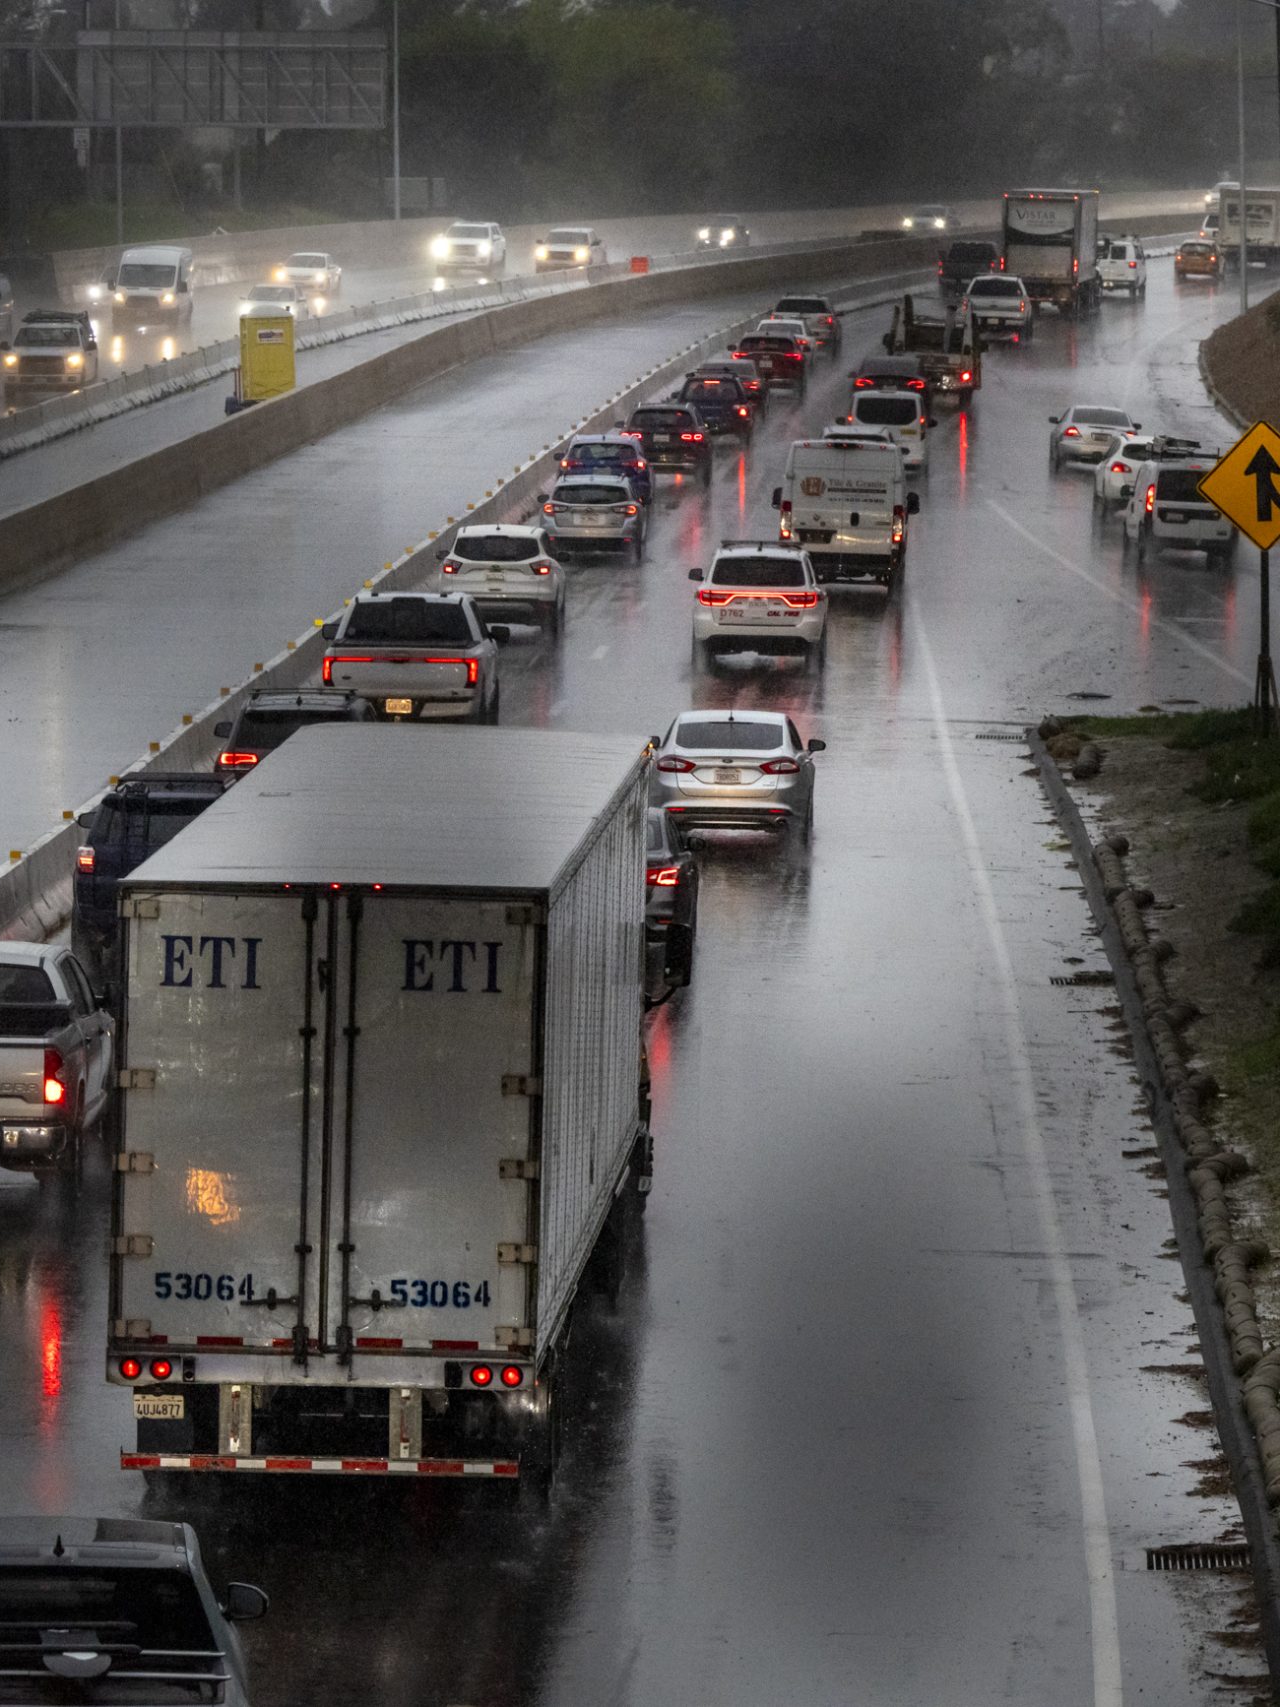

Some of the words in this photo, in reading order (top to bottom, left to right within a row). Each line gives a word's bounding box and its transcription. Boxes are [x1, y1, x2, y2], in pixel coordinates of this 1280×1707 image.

[1016, 208, 1056, 220] VISTAR
[160, 935, 262, 989] ETI
[402, 939, 503, 993] ETI
[155, 1272, 255, 1302] 53064
[390, 1279, 492, 1308] 53064
[136, 1403, 181, 1416] 4UJ4877
